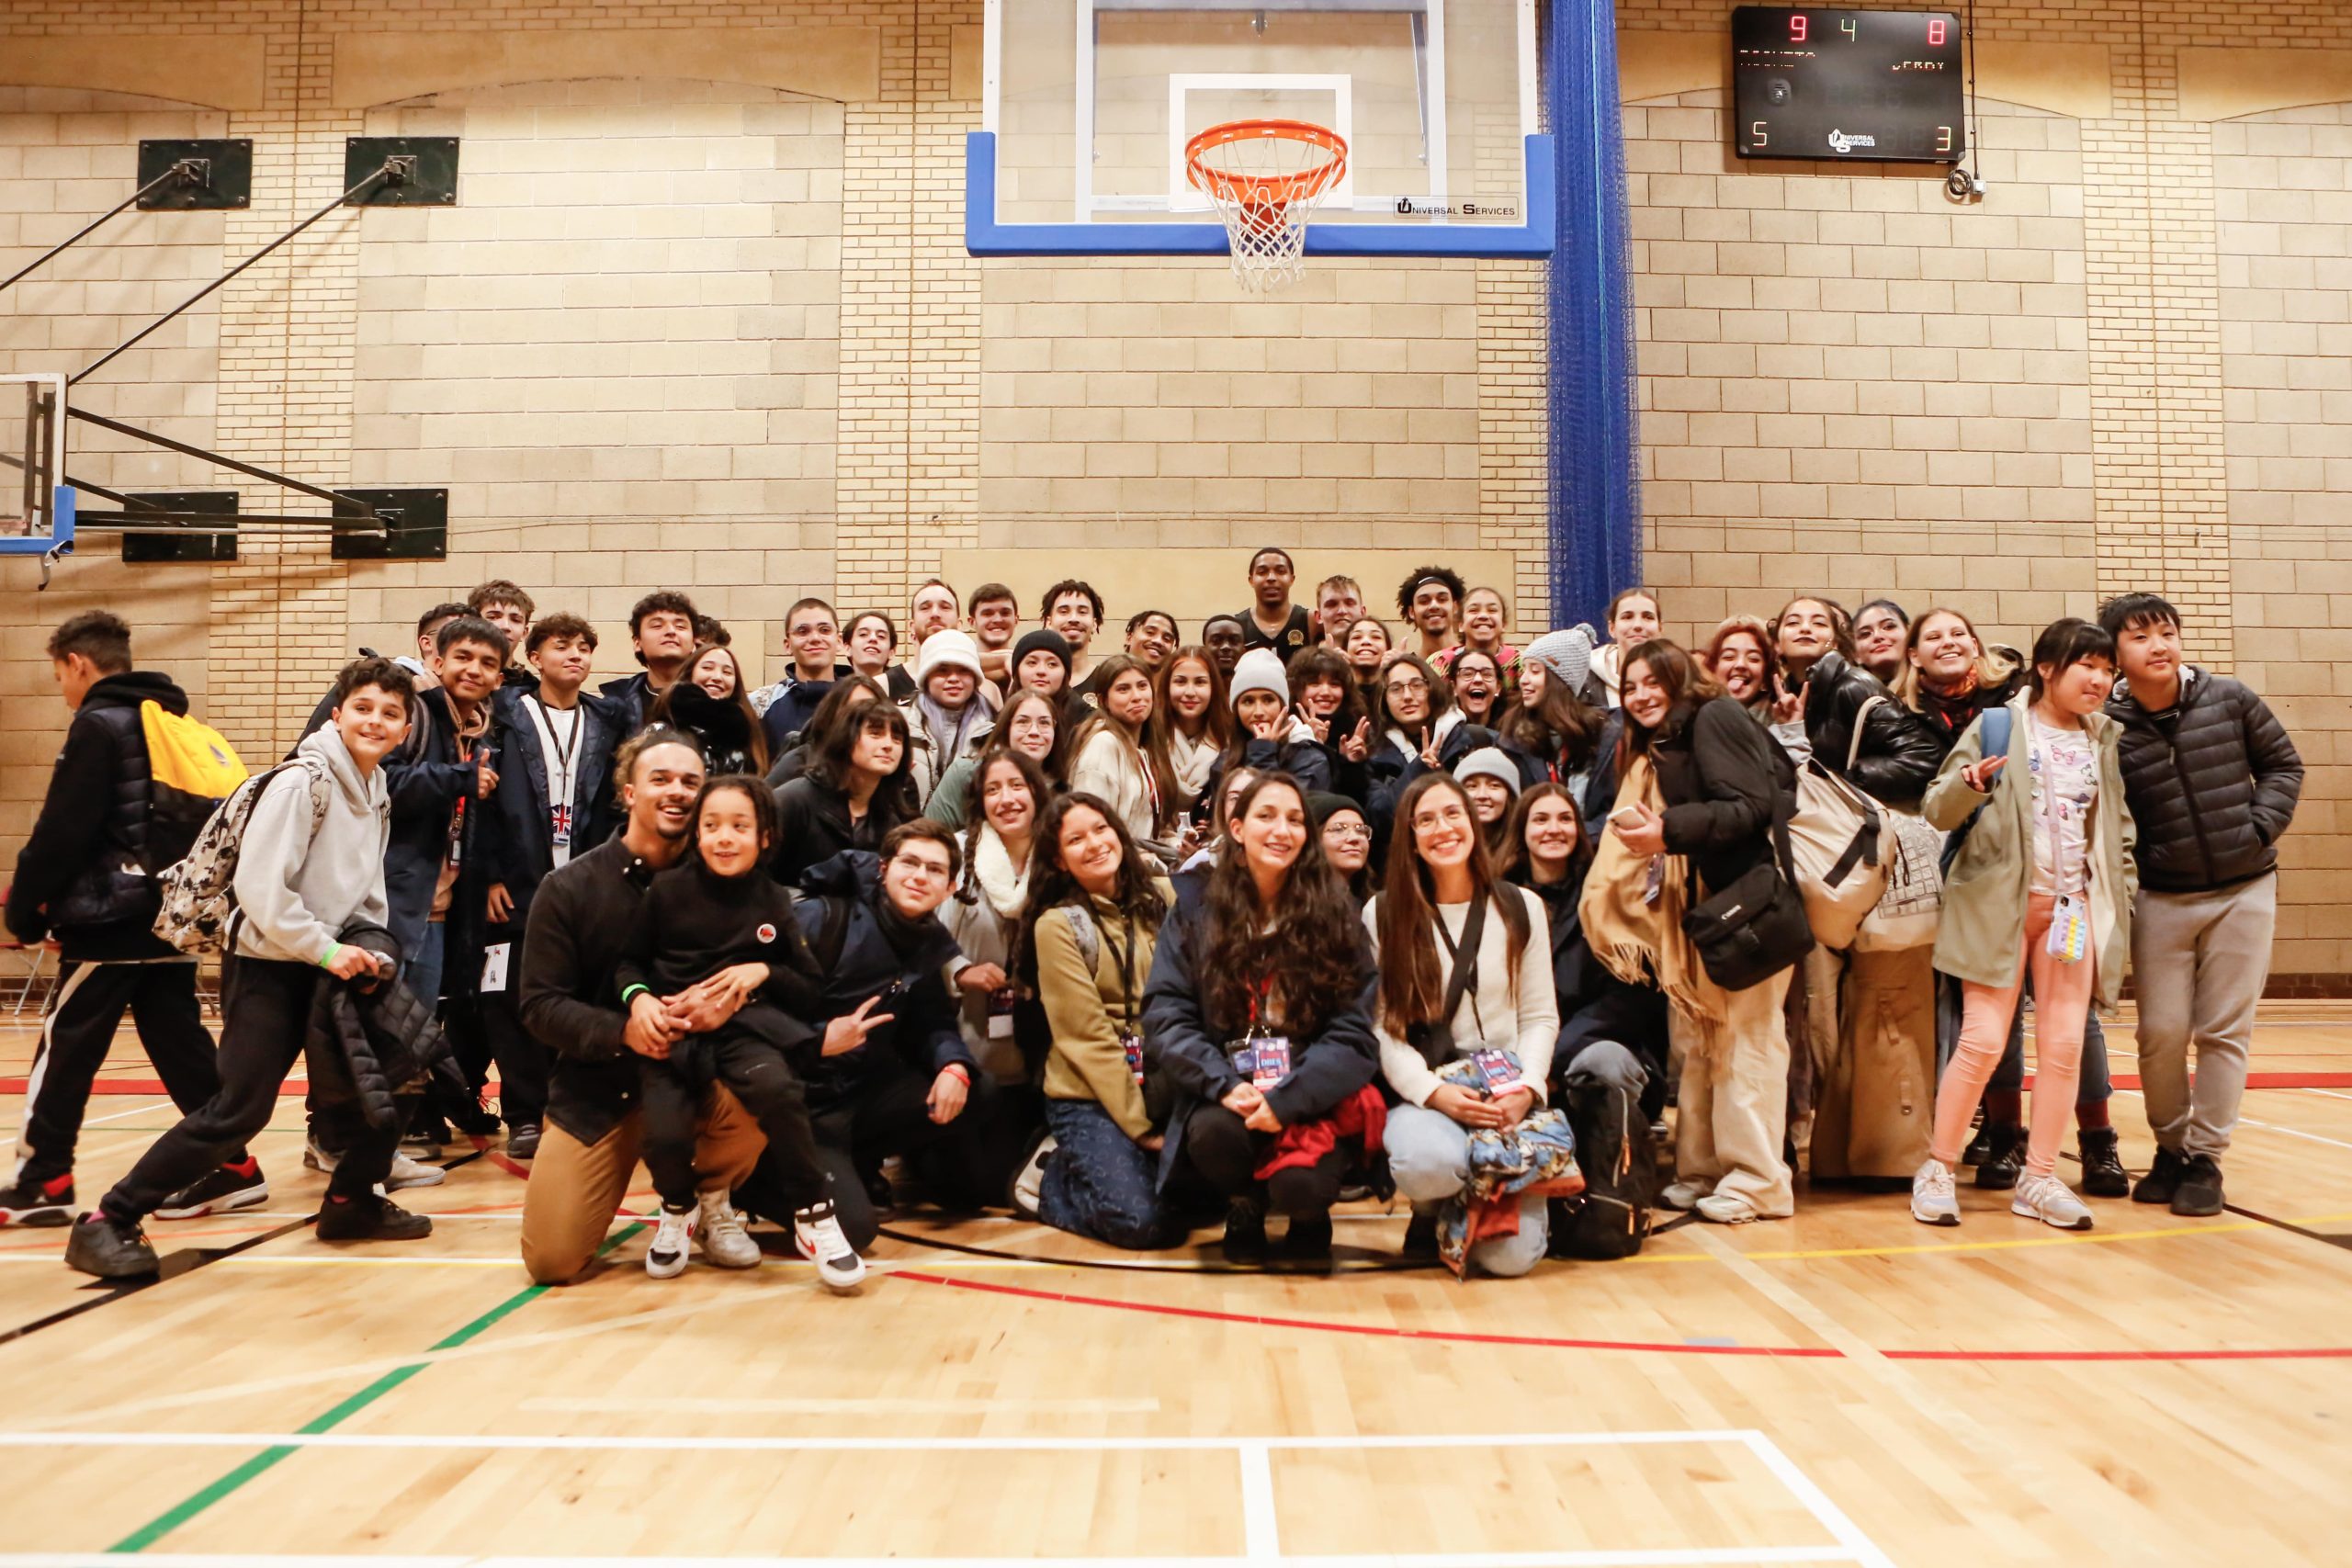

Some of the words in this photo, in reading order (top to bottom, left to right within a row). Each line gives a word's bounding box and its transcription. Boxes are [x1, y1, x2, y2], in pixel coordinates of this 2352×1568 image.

[1791, 16, 1807, 41] 9
[1841, 18, 1856, 42] 4
[1753, 121, 1767, 146] 5
[1937, 126, 1951, 151] 3
[1397, 197, 1458, 215] UNIVERSAL
[1463, 204, 1515, 215] SERVICES
